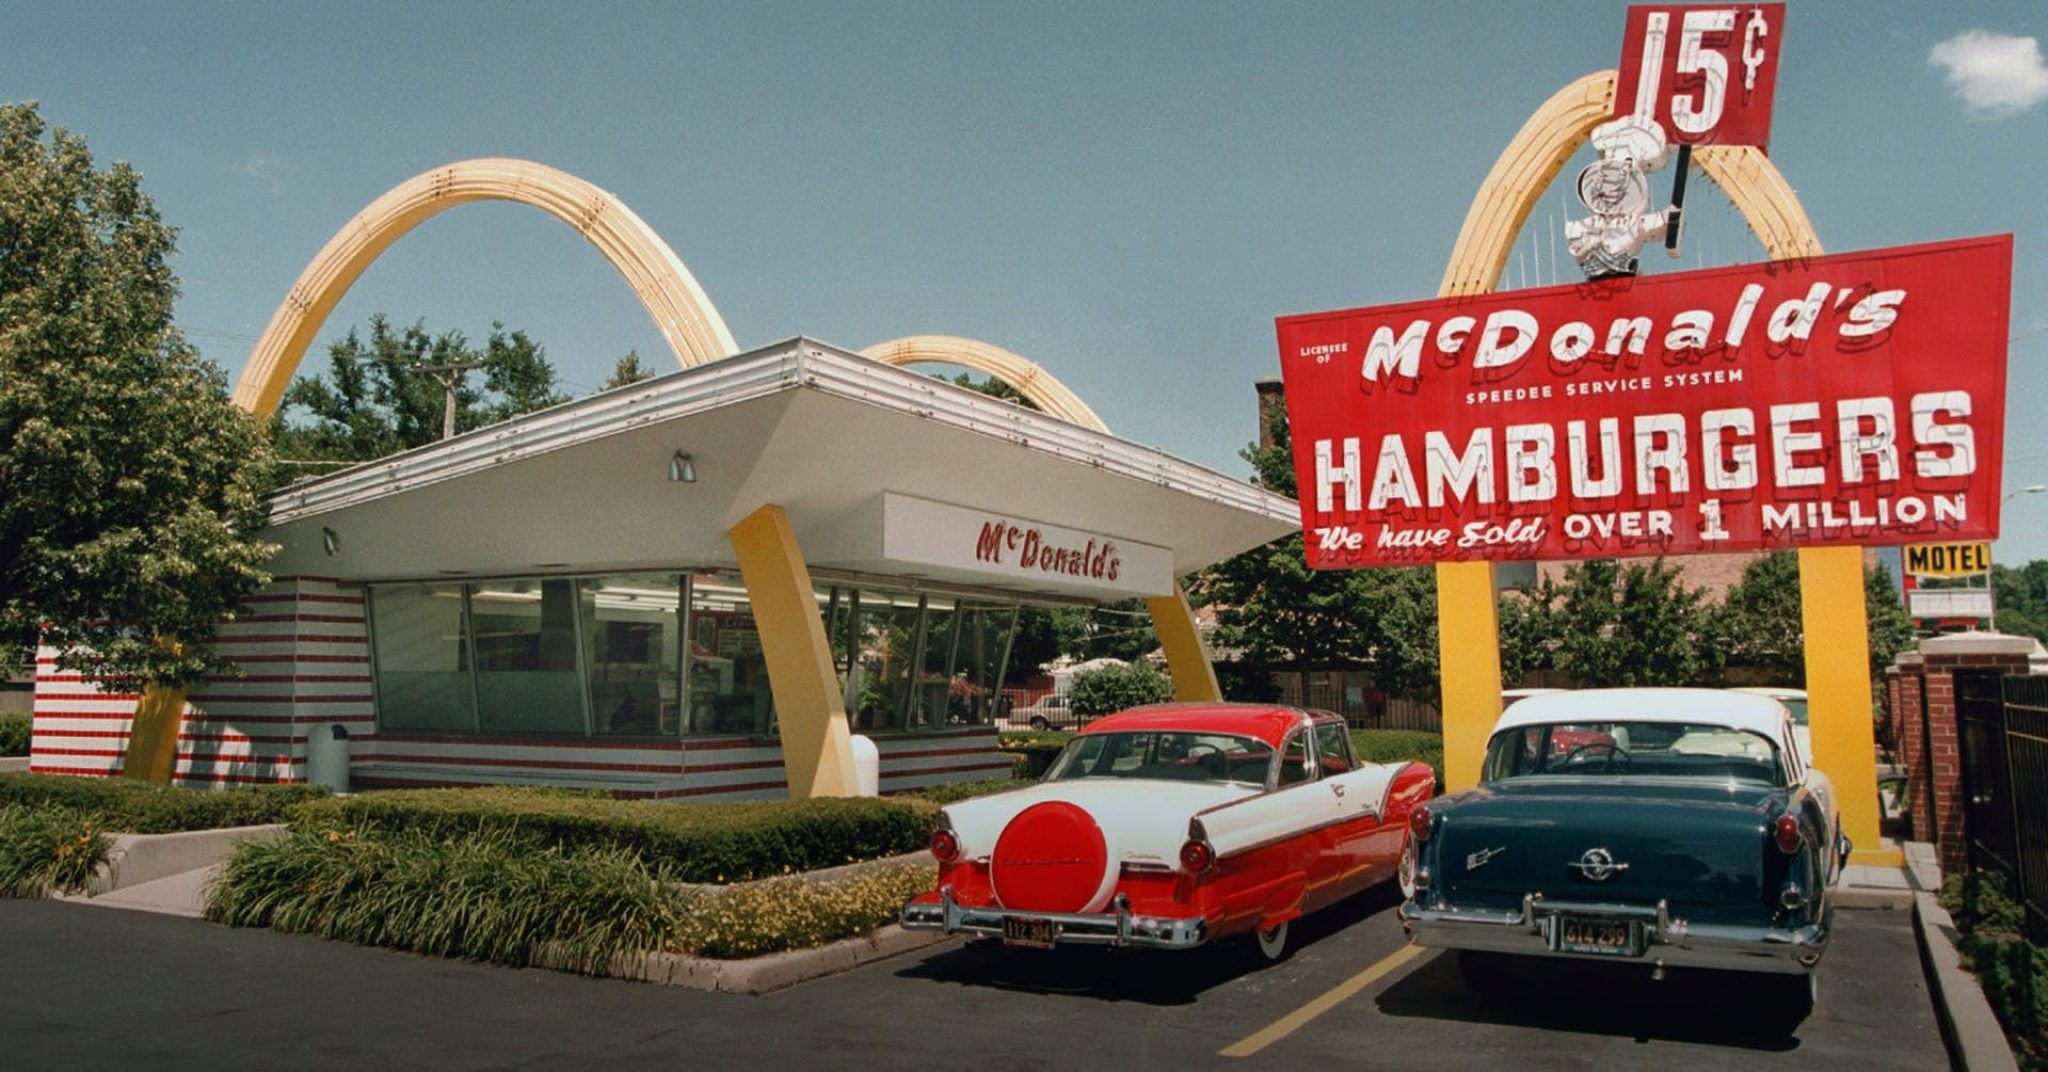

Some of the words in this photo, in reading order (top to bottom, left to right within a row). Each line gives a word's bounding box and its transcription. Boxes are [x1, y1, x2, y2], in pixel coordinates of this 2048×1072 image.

[1300, 342, 1348, 357] LICENSEE
[1361, 282, 1907, 382] McDonald's
[1317, 354, 1330, 364] OF
[1466, 386, 1552, 405] SPEEDEE
[1567, 377, 1652, 396] SERVICE
[1664, 369, 1743, 387] SYSTEM
[1315, 390, 1976, 513] HAMBURGERS
[1314, 526, 1362, 550] We
[1377, 523, 1451, 548] have
[1457, 517, 1547, 547] Sold
[1564, 510, 1674, 539] OVER
[1699, 499, 1730, 540] 1
[1761, 493, 1967, 532] MILLION
[1908, 544, 1987, 571] MOTEL
